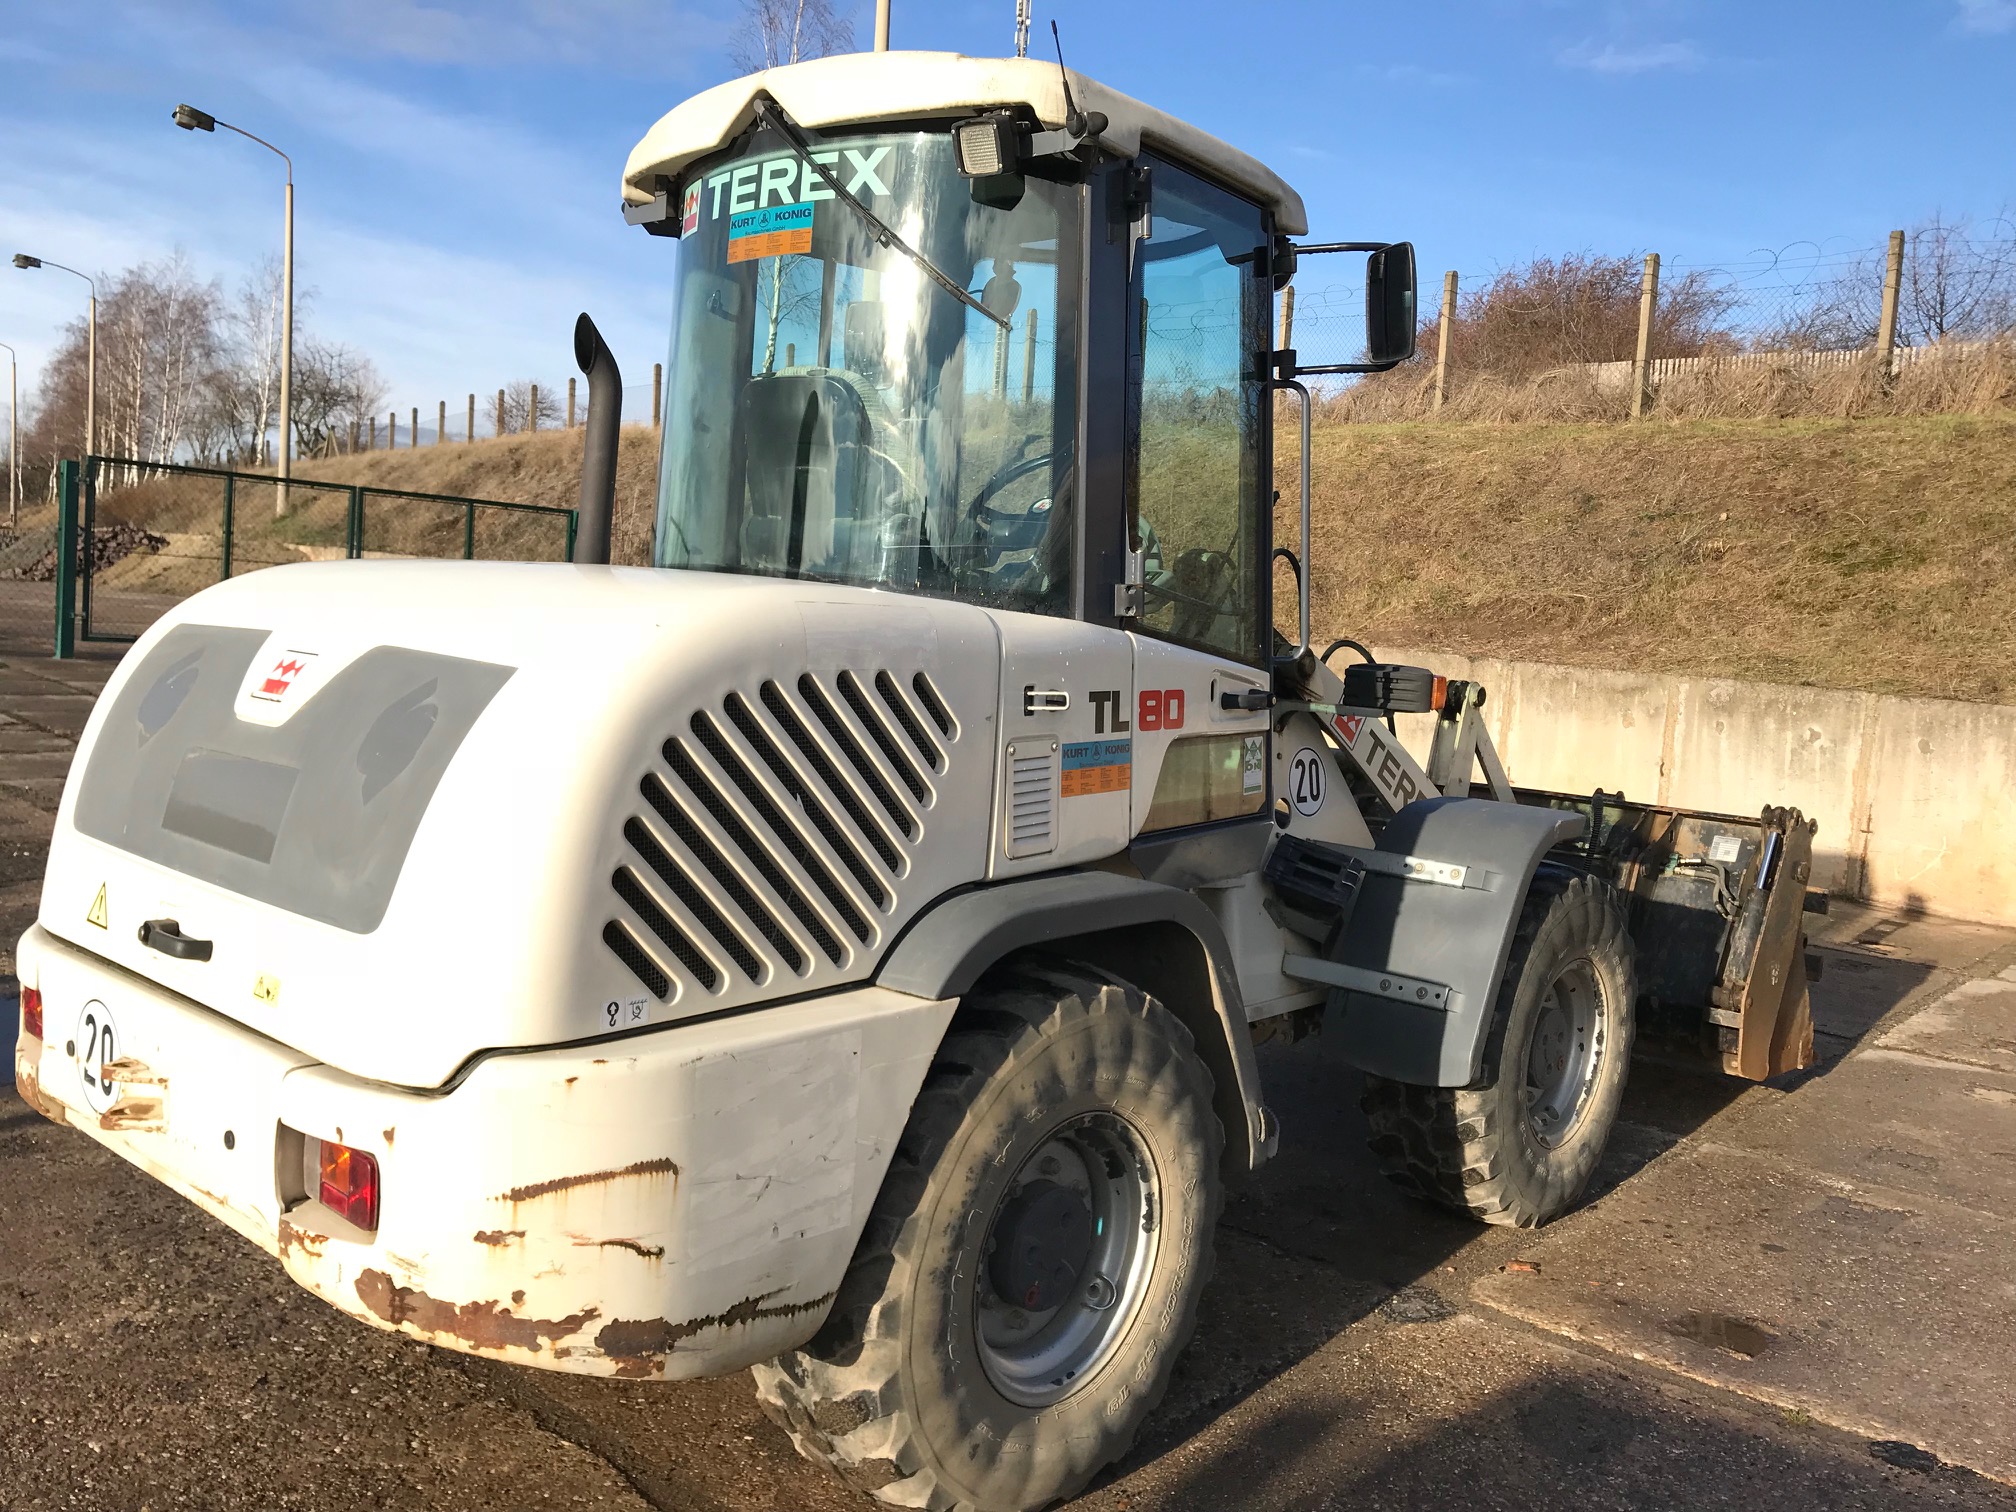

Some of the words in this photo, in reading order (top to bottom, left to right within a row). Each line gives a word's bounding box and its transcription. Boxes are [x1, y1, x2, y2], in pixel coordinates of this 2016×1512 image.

[708, 147, 891, 220] TEREX
[731, 217, 756, 229] KURT
[1139, 689, 1185, 731] 80
[1063, 748, 1089, 759] KURT
[1295, 758, 1320, 804] 20
[1366, 728, 1428, 808] TER
[84, 1013, 114, 1096] 20
[1160, 1216, 1193, 1332] DUNLOP
